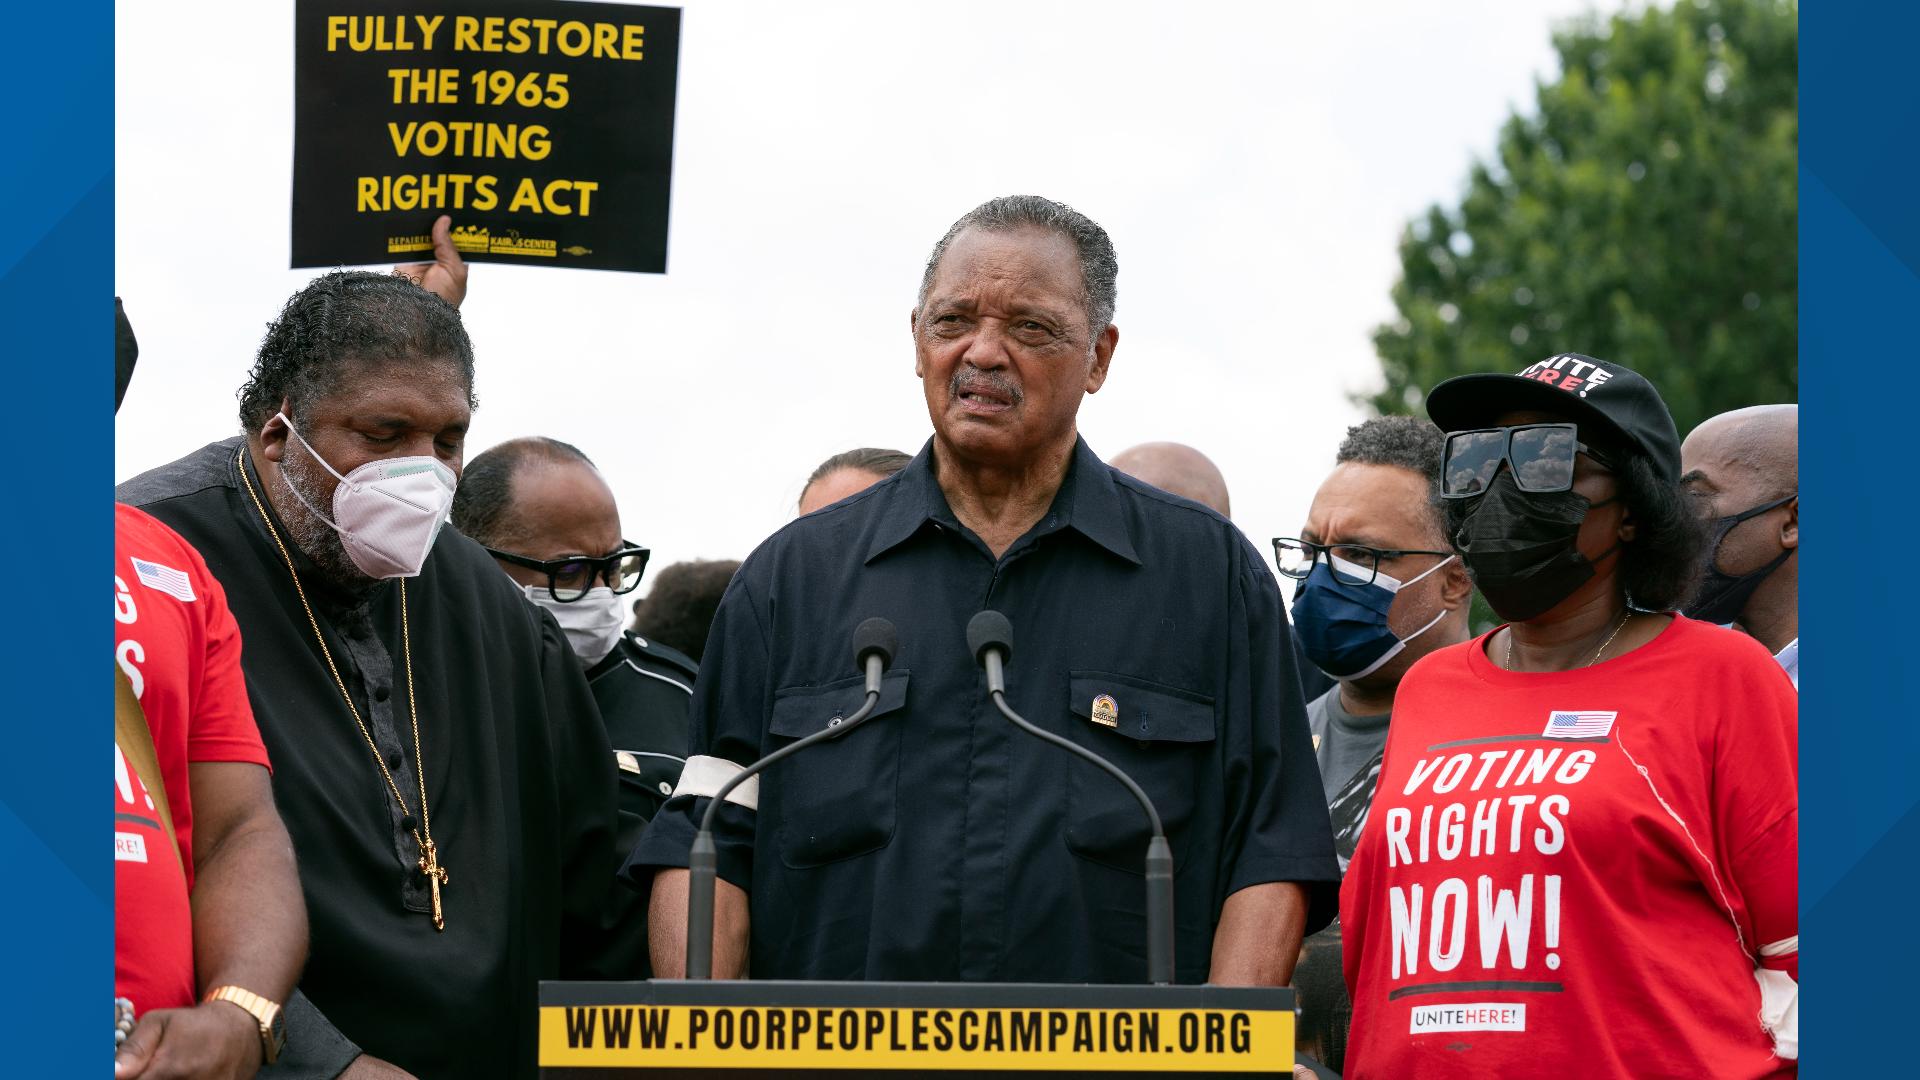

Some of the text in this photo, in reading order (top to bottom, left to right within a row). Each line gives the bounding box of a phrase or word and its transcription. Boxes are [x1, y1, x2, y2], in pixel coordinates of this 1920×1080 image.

[328, 16, 644, 60] FULLY RESTORE
[388, 69, 569, 108] THE 1965
[388, 122, 552, 160] VOTING
[357, 174, 598, 216] RIGHTS ACT
[524, 239, 557, 250] CENTER
[1403, 748, 1597, 796] VOTING
[1386, 795, 1570, 868] RIGHTS
[1389, 874, 1562, 980] NOW!
[565, 1008, 1251, 1054] WWW.POORPEOPLESCAMPAIGN.ORG
